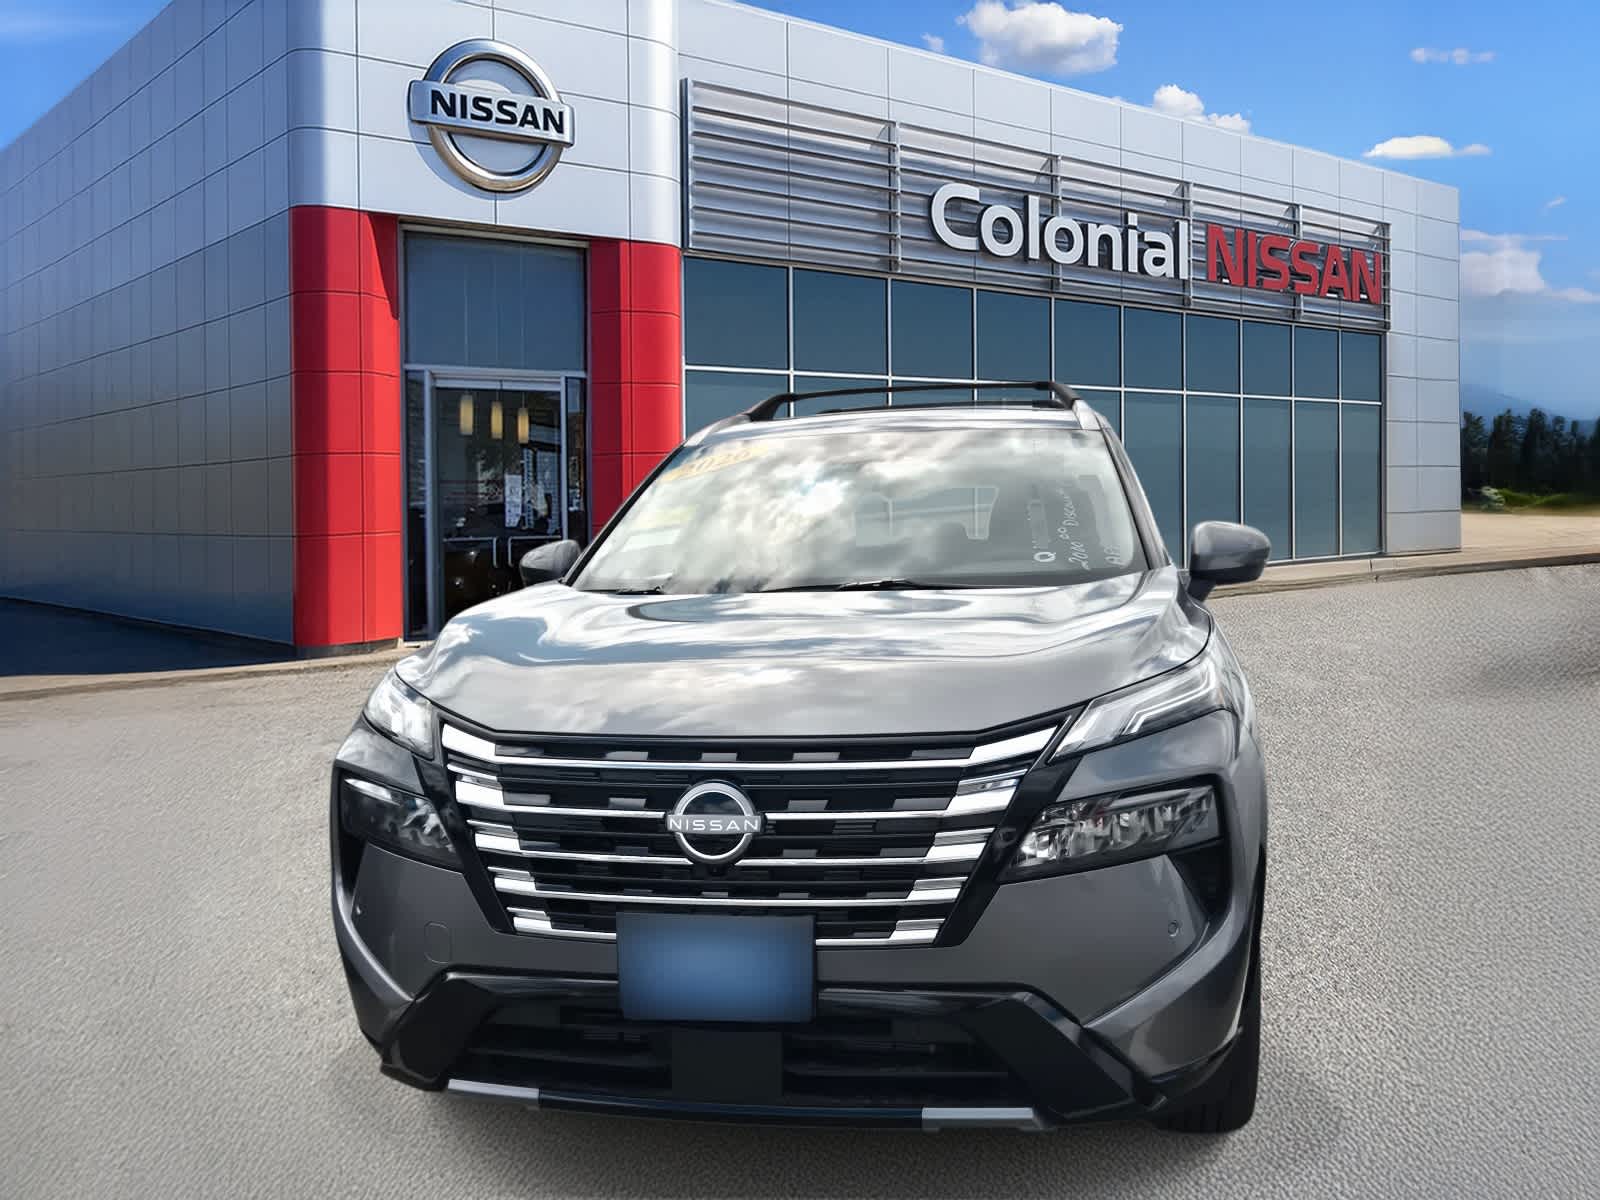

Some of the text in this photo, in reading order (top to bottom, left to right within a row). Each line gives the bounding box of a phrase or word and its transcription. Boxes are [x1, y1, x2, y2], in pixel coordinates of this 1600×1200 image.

[430, 89, 564, 134] NISSAN
[928, 182, 1383, 305] Colonial NISSAN
[669, 818, 759, 832] NISSAN
